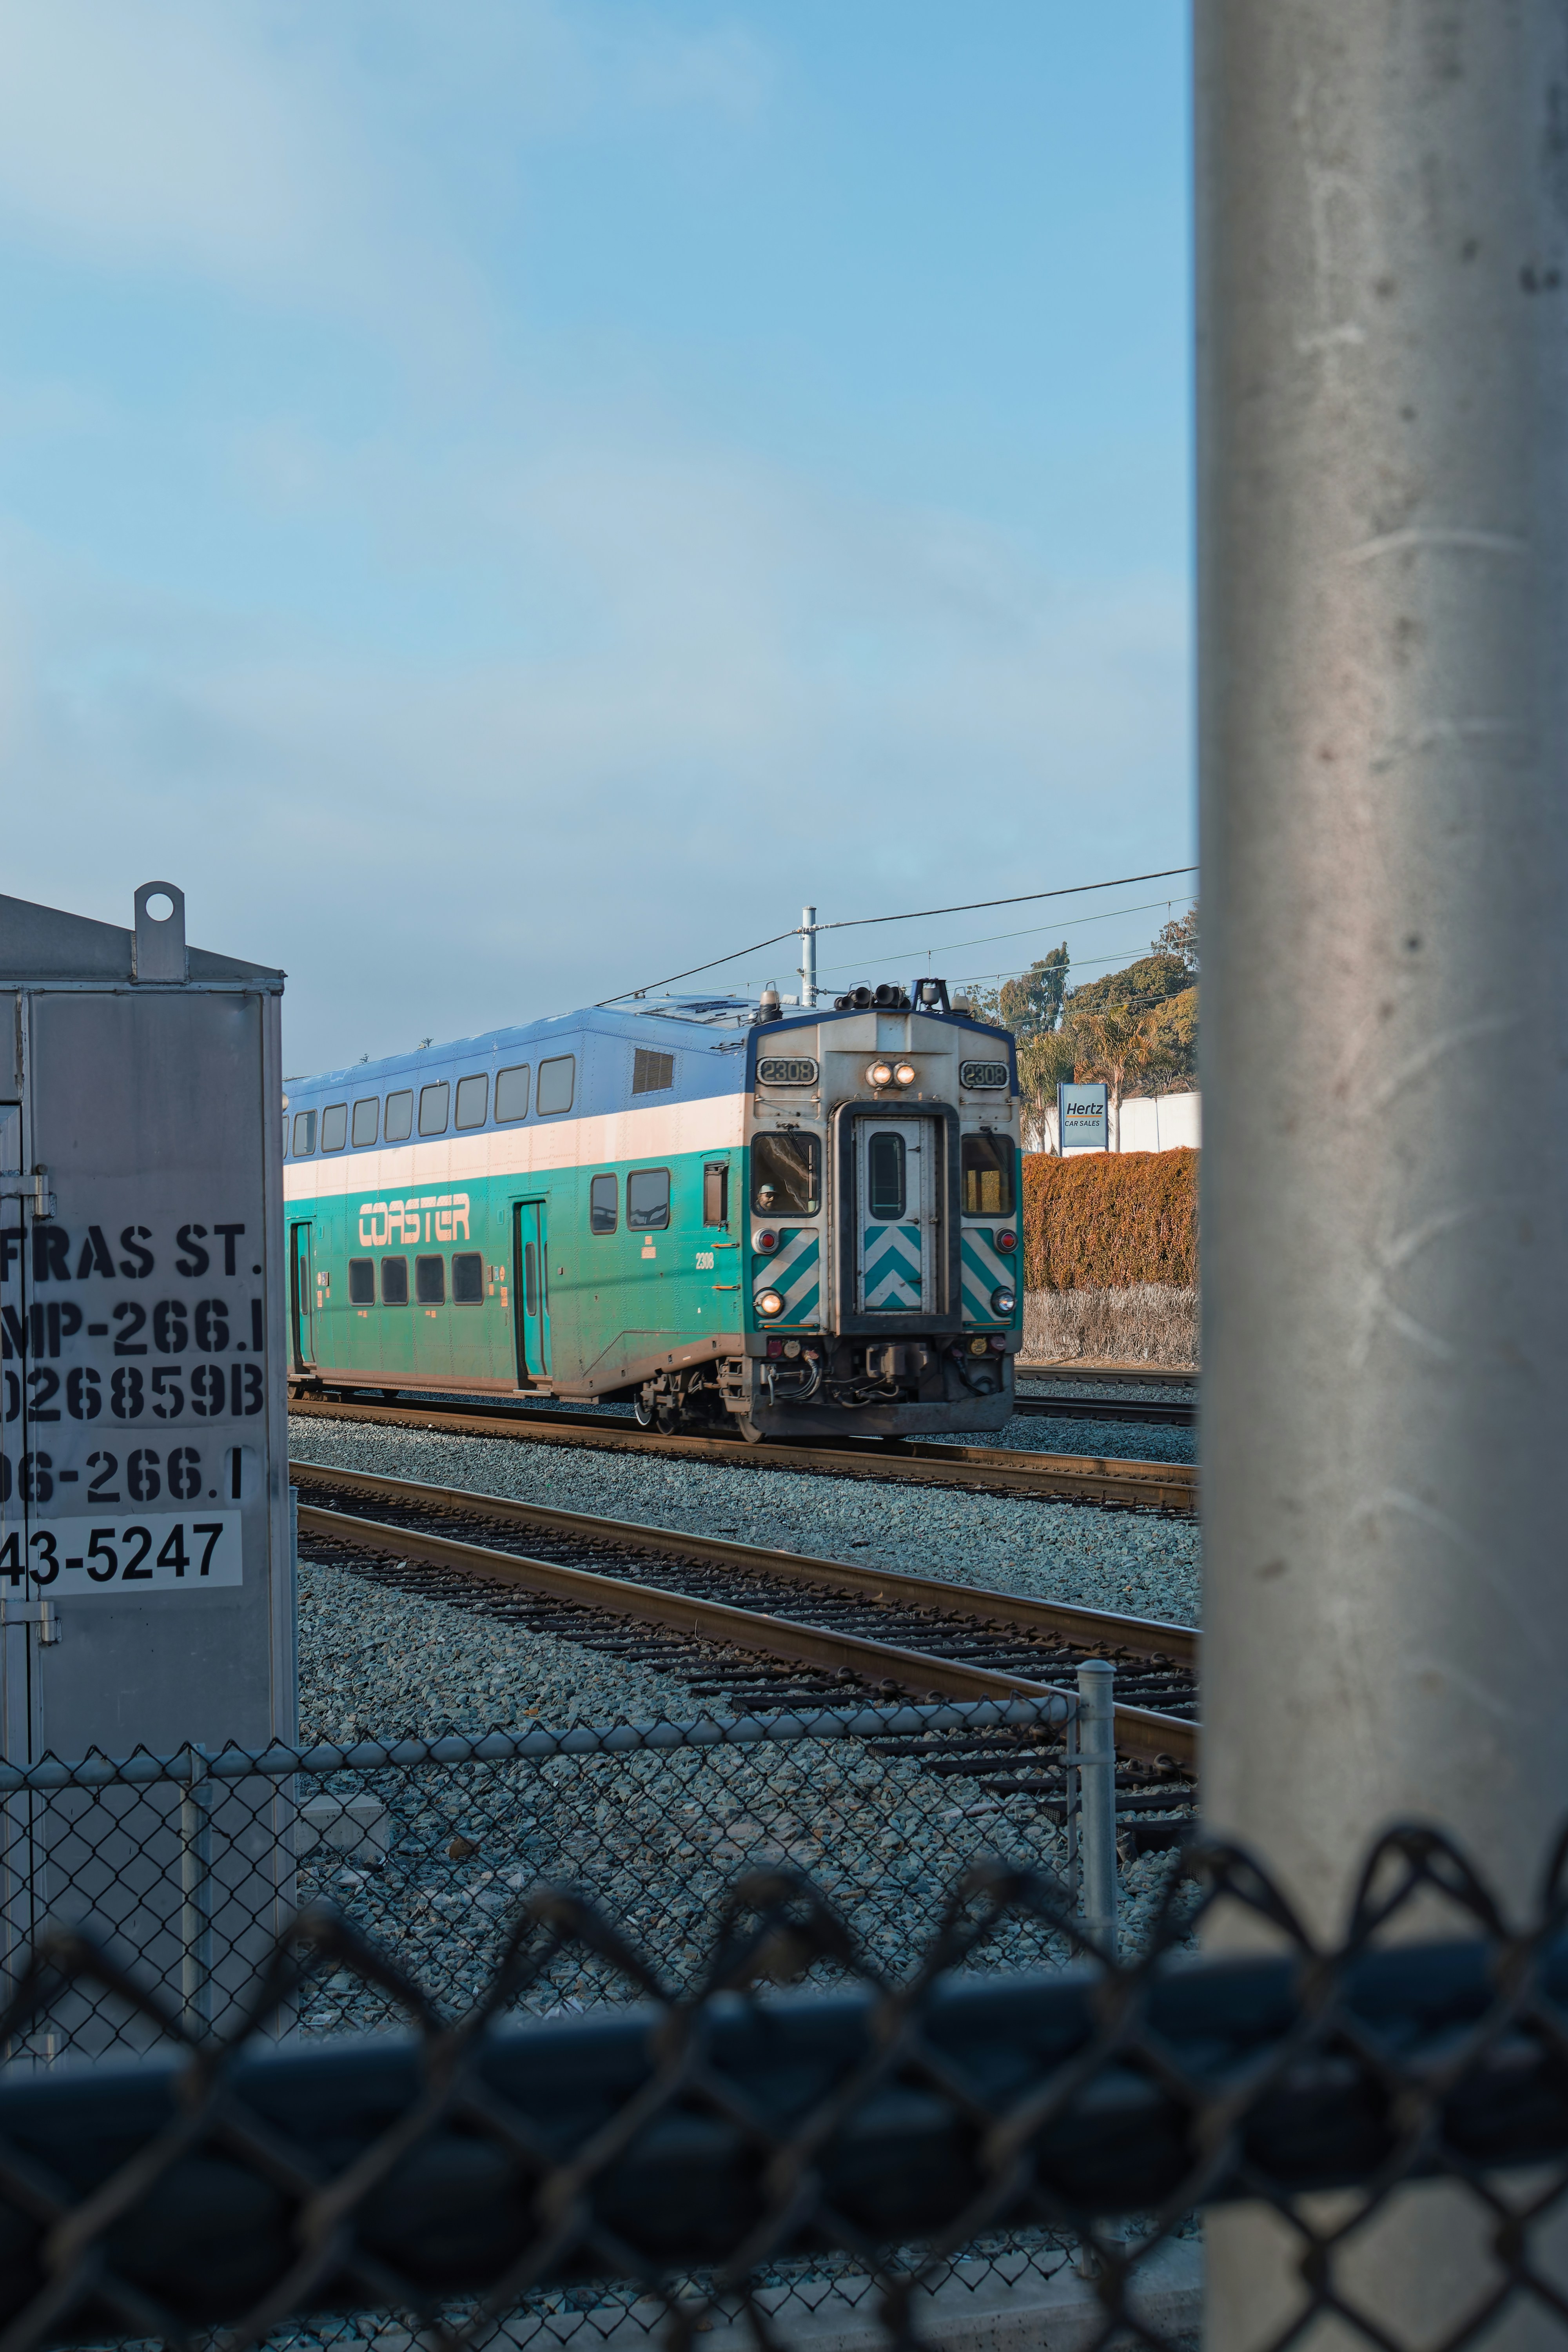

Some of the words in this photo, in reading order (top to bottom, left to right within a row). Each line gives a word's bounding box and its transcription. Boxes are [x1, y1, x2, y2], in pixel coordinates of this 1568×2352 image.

[764, 1061, 811, 1081] 2308
[965, 1065, 1004, 1084] 2308
[1067, 1103, 1103, 1114] Hertz
[359, 1193, 470, 1247] COASTER
[0, 1225, 154, 1281] FRAS
[175, 1224, 261, 1278] ST.
[696, 1252, 714, 1269] 2308
[0, 1523, 223, 1587] 43-5247
